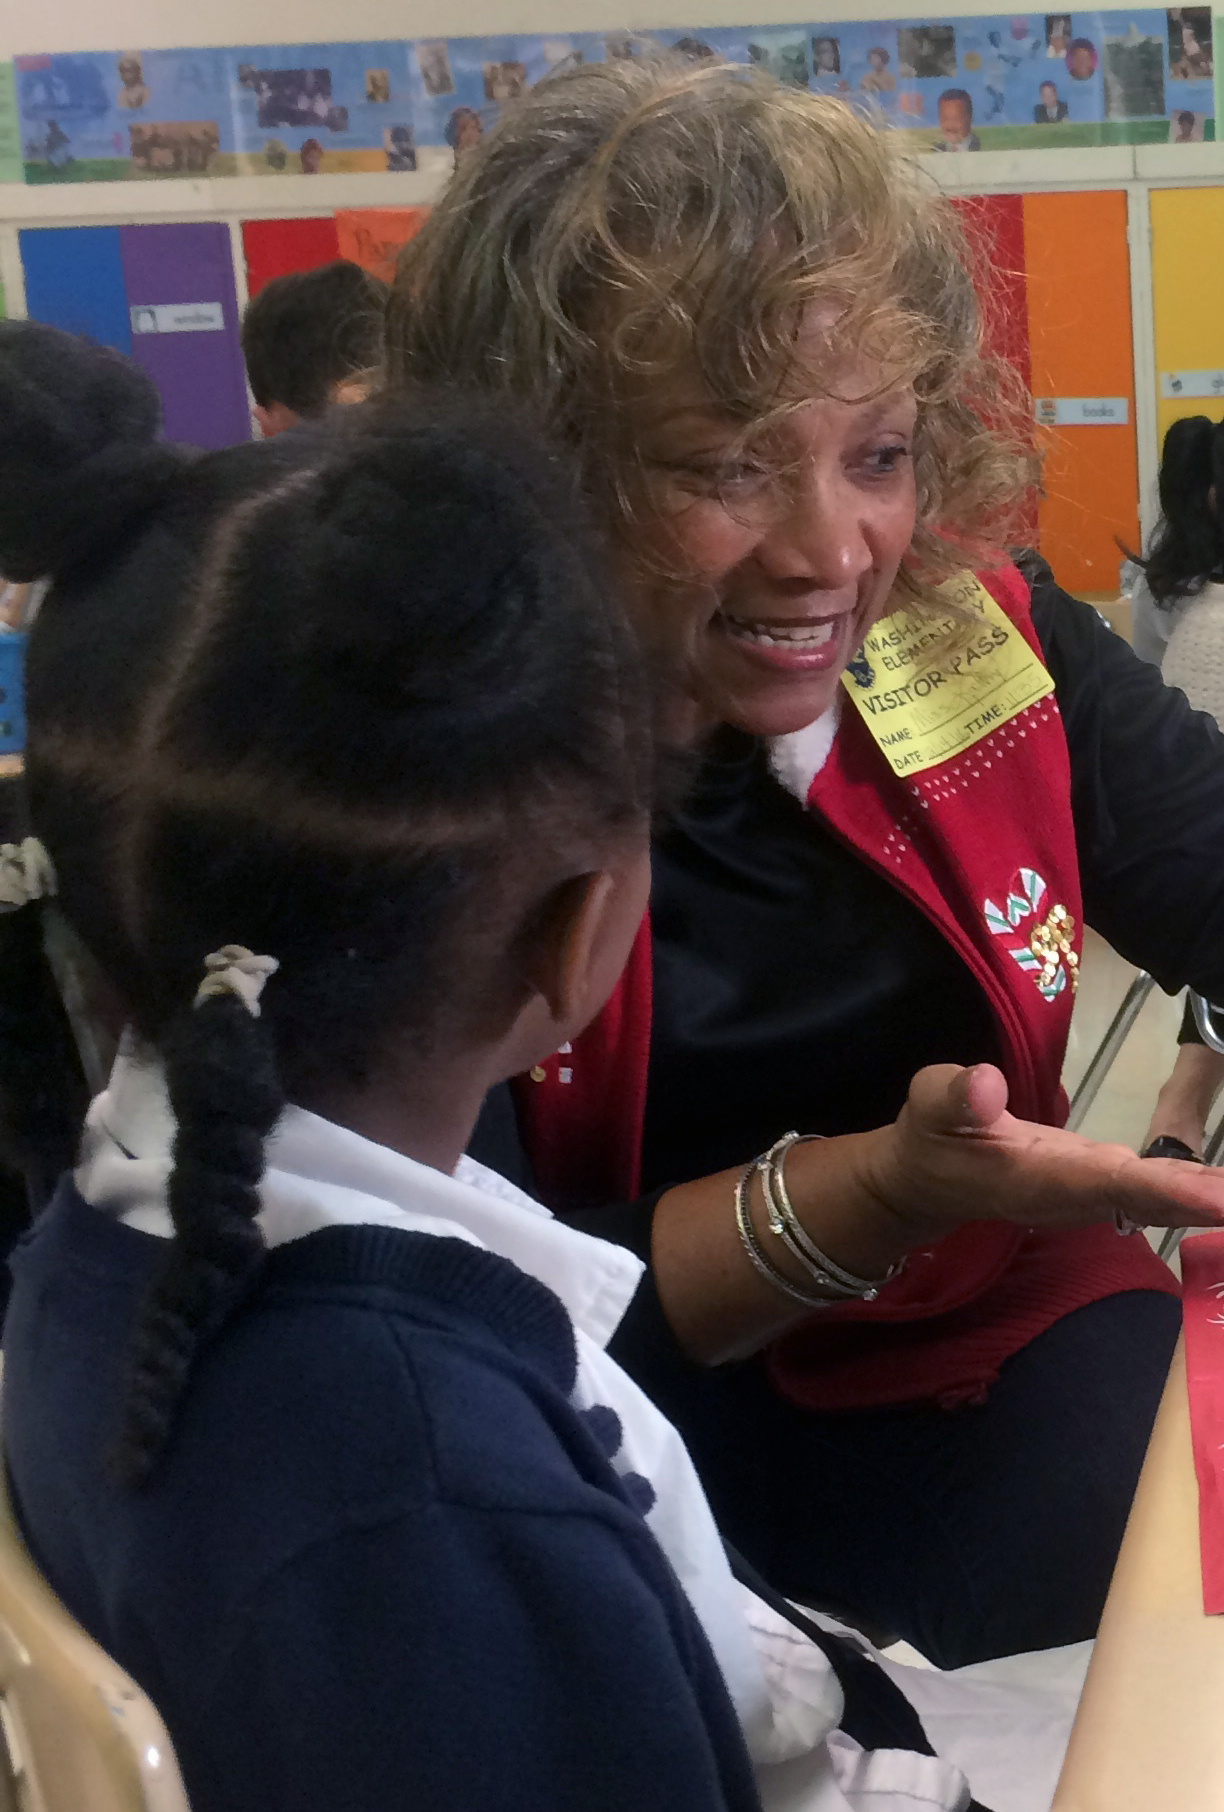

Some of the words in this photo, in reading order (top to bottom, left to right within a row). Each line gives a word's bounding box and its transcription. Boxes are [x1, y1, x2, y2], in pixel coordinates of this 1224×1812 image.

[862, 669, 948, 715] VISITOR
[948, 625, 1010, 676] PASS
[964, 702, 1007, 735] TIME:
